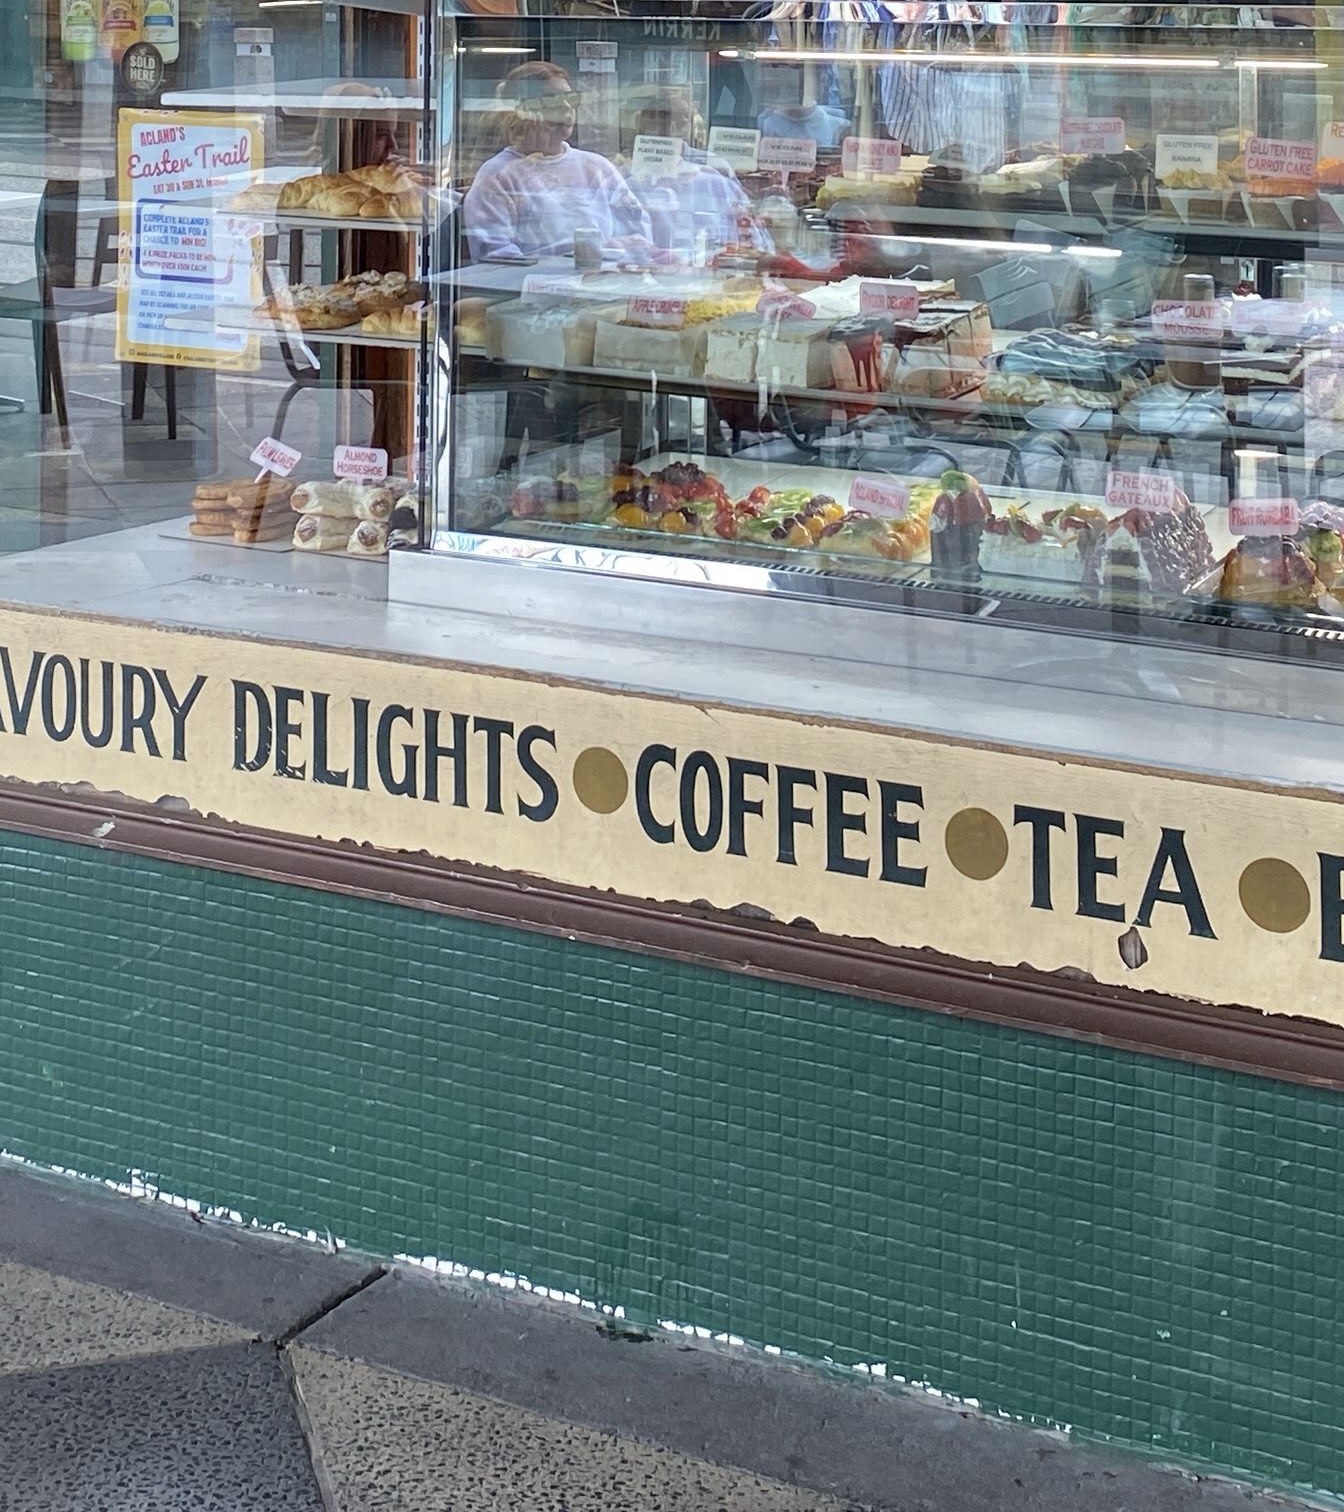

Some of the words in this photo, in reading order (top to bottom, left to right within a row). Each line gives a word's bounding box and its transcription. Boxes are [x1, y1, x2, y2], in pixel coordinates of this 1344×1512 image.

[140, 126, 186, 147] ACLAND'S
[1163, 140, 1191, 149] GLUTEN
[1193, 141, 1214, 151] FREE
[1250, 143, 1287, 159] GLUTEN
[1289, 145, 1314, 160] FREE
[127, 149, 194, 180] Easter
[194, 136, 250, 172] Trail
[1247, 157, 1285, 173] CARROT
[1286, 161, 1312, 177] CAKE
[1153, 303, 1219, 319] CHOCOLATE
[1163, 322, 1209, 334] MOUSSE
[343, 449, 378, 463] ALMOND
[336, 462, 384, 477] HORSESHOE
[1112, 473, 1170, 491] FRENCH
[1108, 490, 1171, 509] GATEAUX
[230, 678, 559, 823] DELIGHTS
[635, 742, 929, 888] COFFEE
[1013, 805, 1218, 940] TEA
